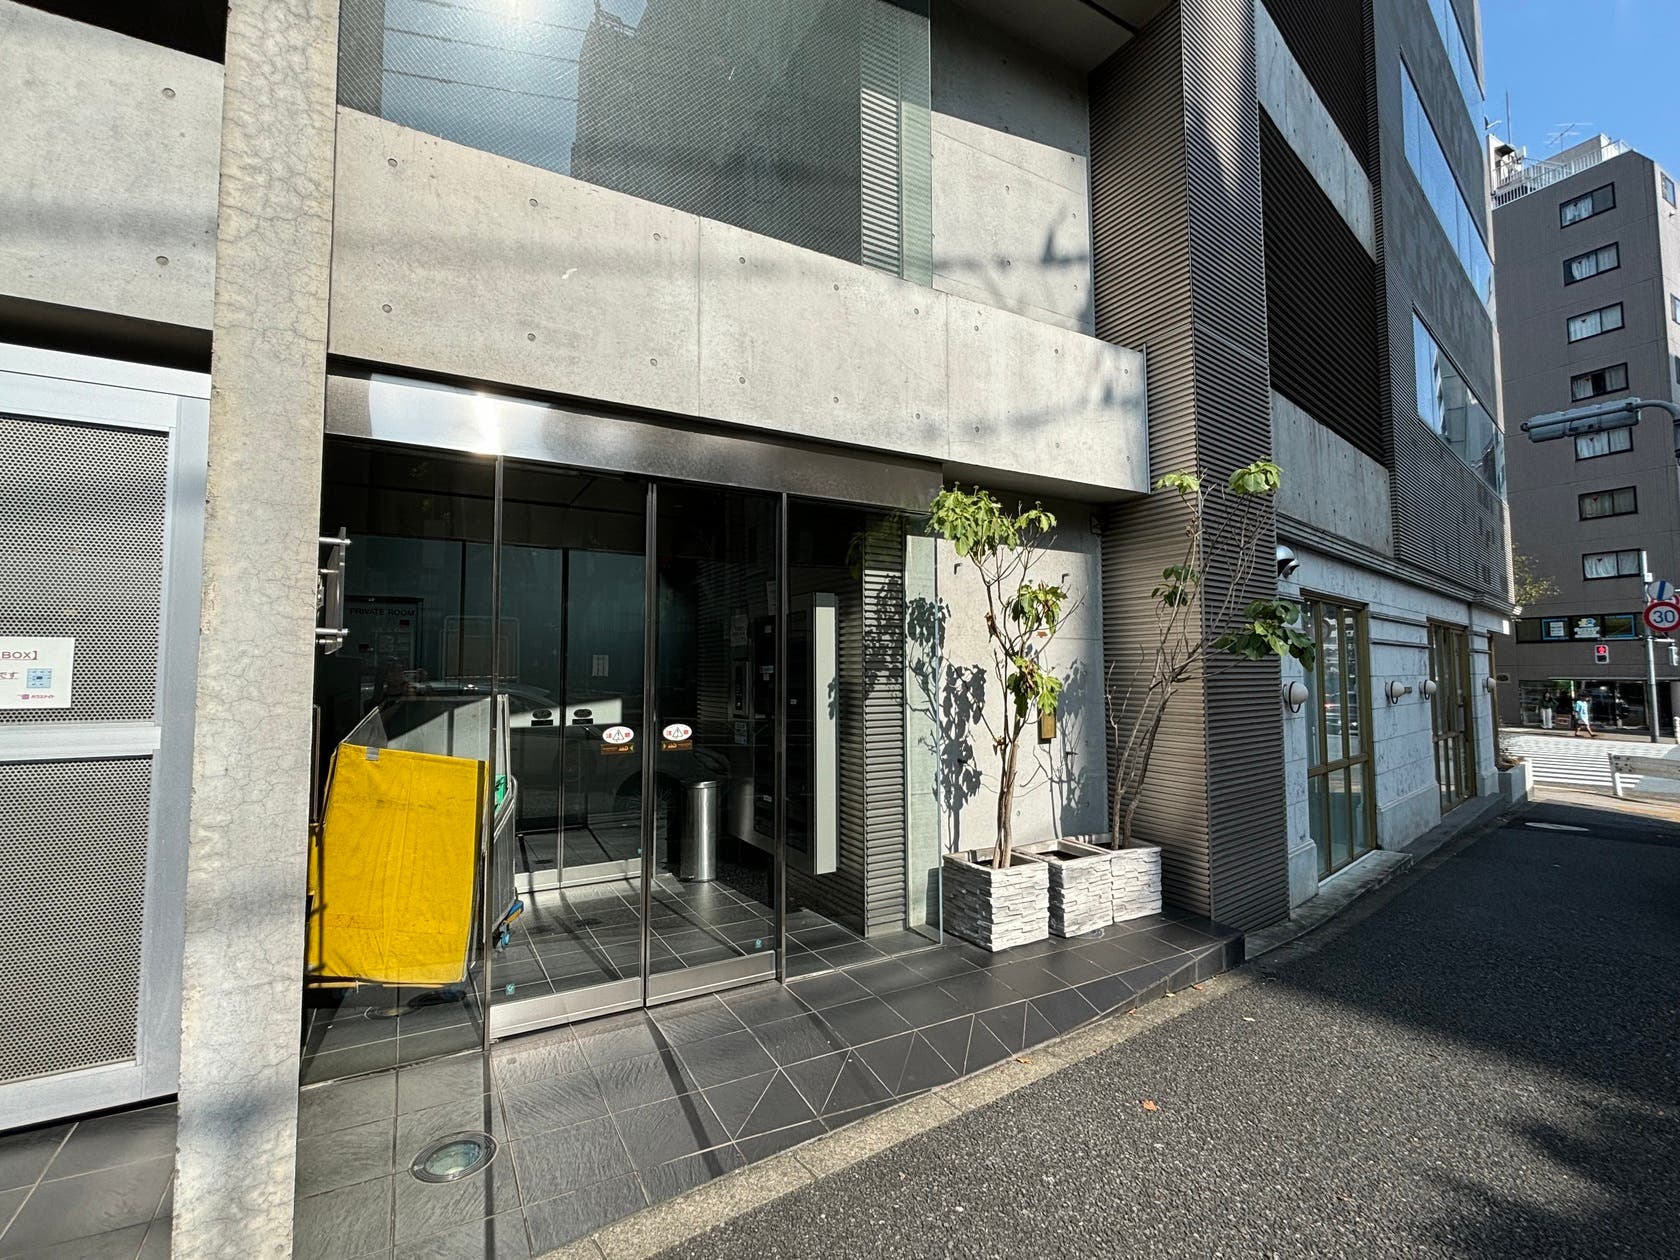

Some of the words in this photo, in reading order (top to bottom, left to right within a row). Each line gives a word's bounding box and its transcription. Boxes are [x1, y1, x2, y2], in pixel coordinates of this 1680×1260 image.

[349, 607, 385, 616] PRIVATE
[388, 607, 416, 617] ROOM
[1653, 609, 1676, 623] 30
